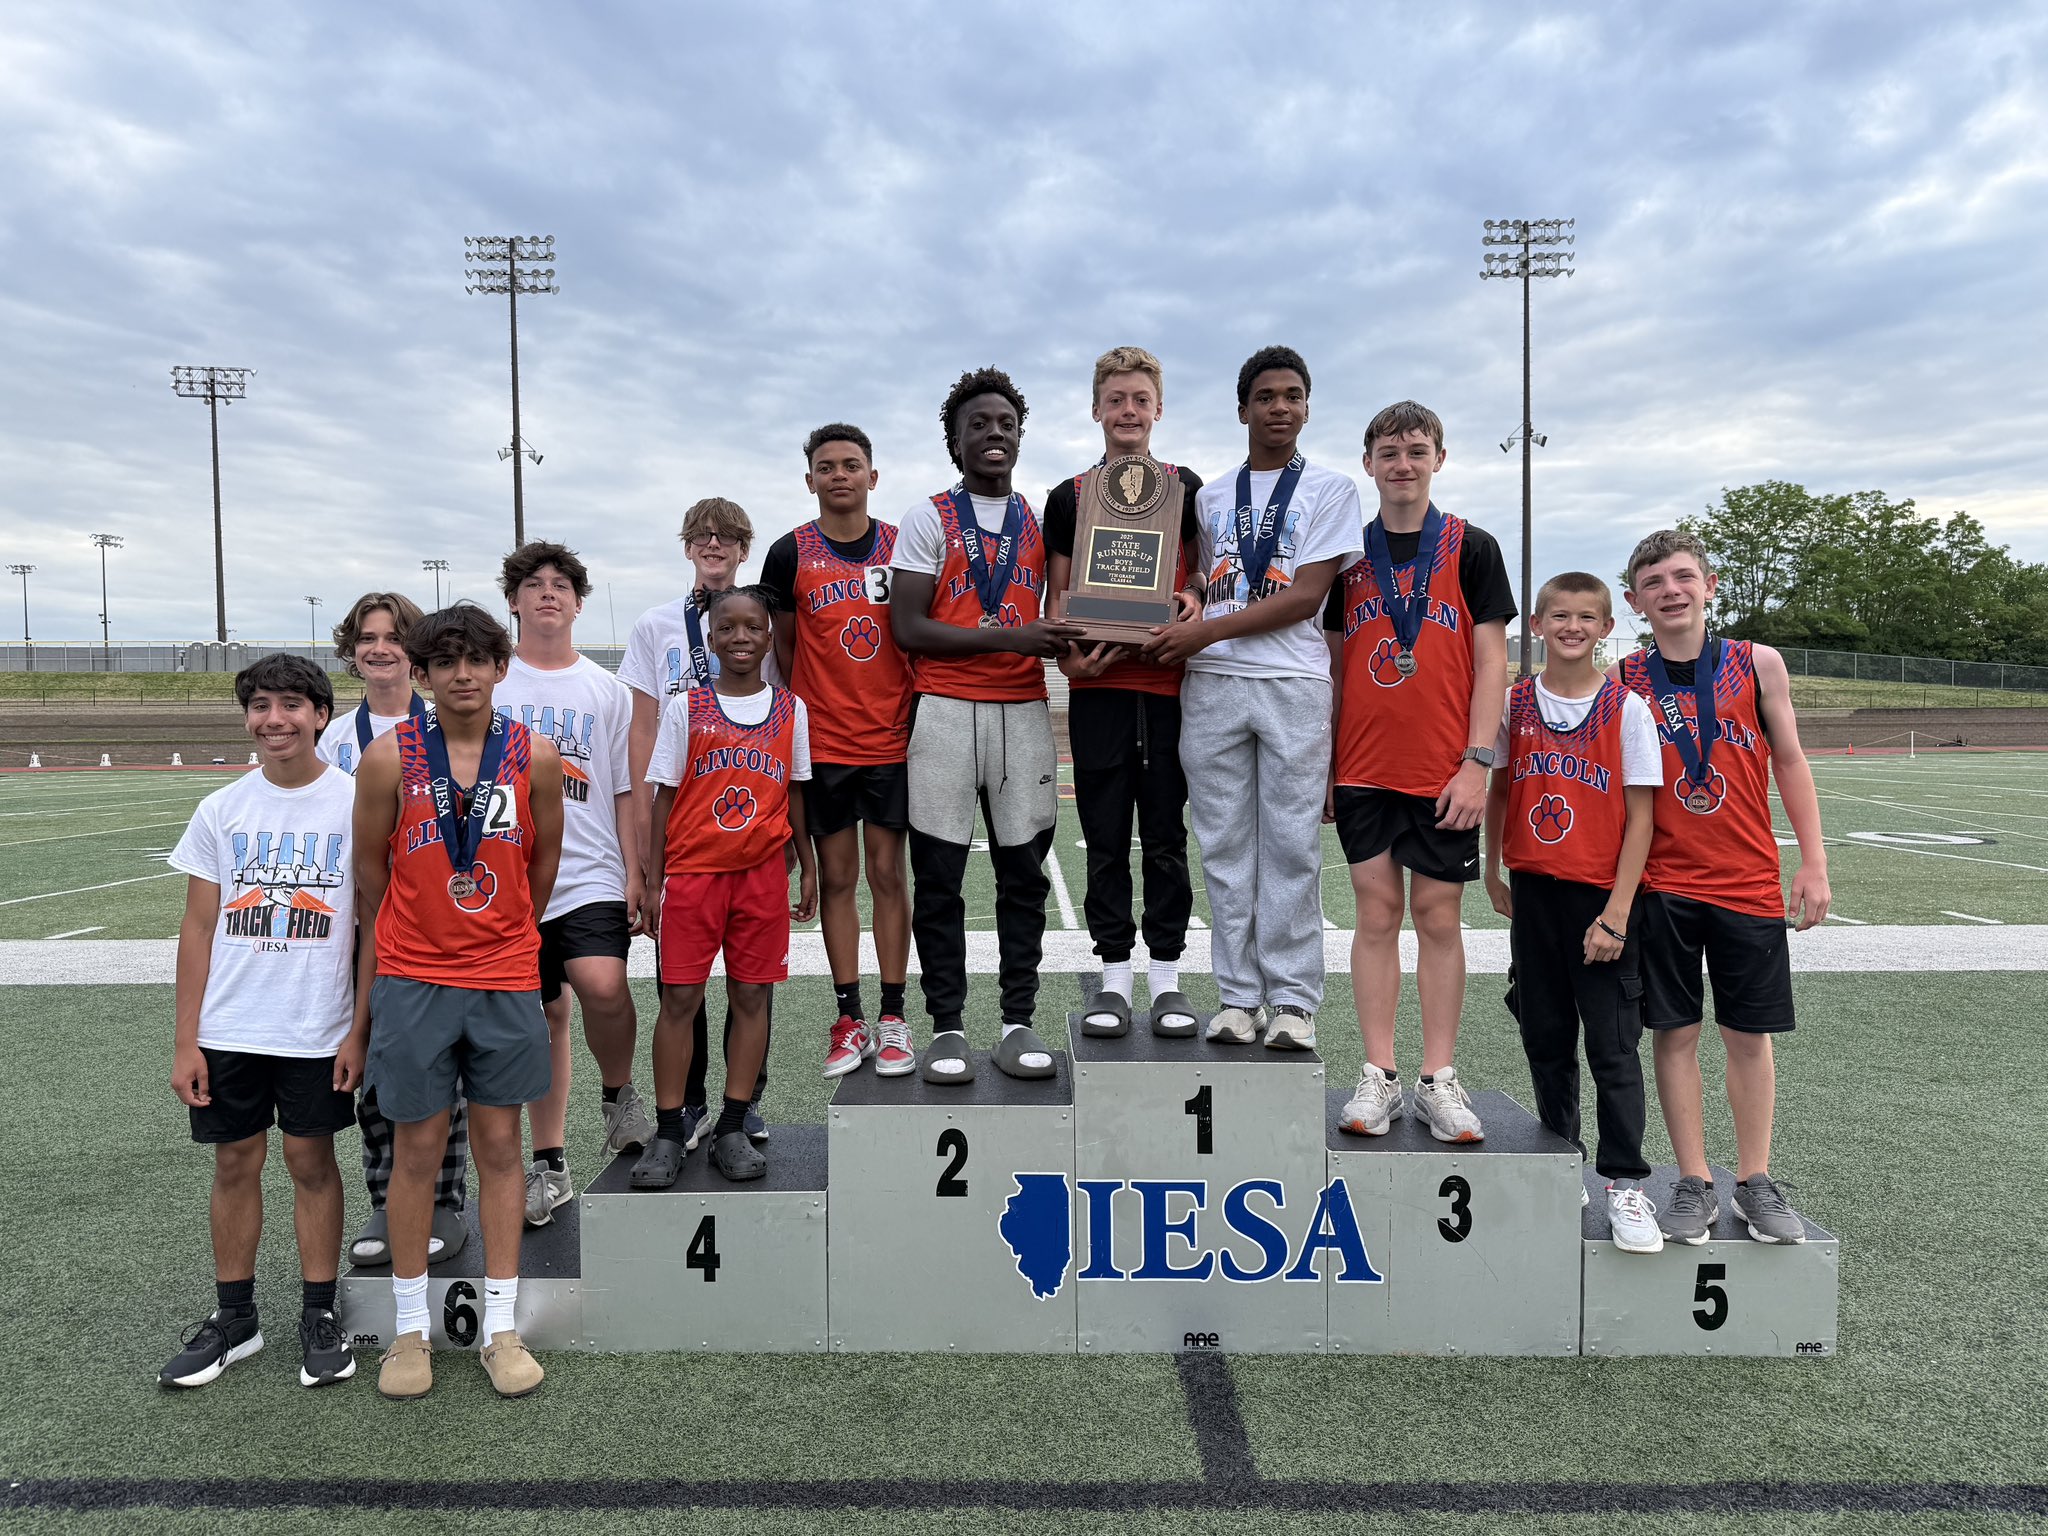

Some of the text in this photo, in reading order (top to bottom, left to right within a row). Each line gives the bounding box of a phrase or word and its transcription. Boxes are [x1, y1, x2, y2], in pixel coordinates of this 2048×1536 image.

[1103, 456, 1162, 508] ILLINOIS ELEMENTARY SCHOOL ASSOCIATION
[1129, 467, 1137, 497] IESA
[1239, 512, 1251, 538] IESA
[1262, 503, 1279, 531] IESA
[965, 536, 979, 562] IESA
[998, 535, 1012, 561] IESA
[1096, 549, 1153, 562] RUNNER-UP
[1111, 540, 1140, 549] STATE
[1096, 563, 1120, 571] TRACK
[1128, 566, 1150, 574] FIELD
[1114, 558, 1133, 566] BOYS
[870, 567, 890, 603] 3
[694, 653, 709, 681] IESA
[1664, 702, 1685, 733] IESA
[694, 747, 785, 787] LINCOLN
[434, 785, 450, 818] IESA
[474, 780, 493, 813] IESA
[489, 788, 511, 830] 2
[231, 831, 343, 873] STATE
[230, 867, 345, 888] FINALS
[226, 904, 275, 938] TRACK
[286, 907, 333, 939] FIELD
[261, 942, 289, 953] IESA
[1185, 1085, 1214, 1154] 1
[936, 1128, 969, 1197] 2
[1437, 1175, 1472, 1243] 3
[1077, 1177, 1384, 1284] IESA
[686, 1215, 720, 1282] 4
[1692, 1263, 1728, 1331] 5
[444, 1281, 478, 1347] 6
